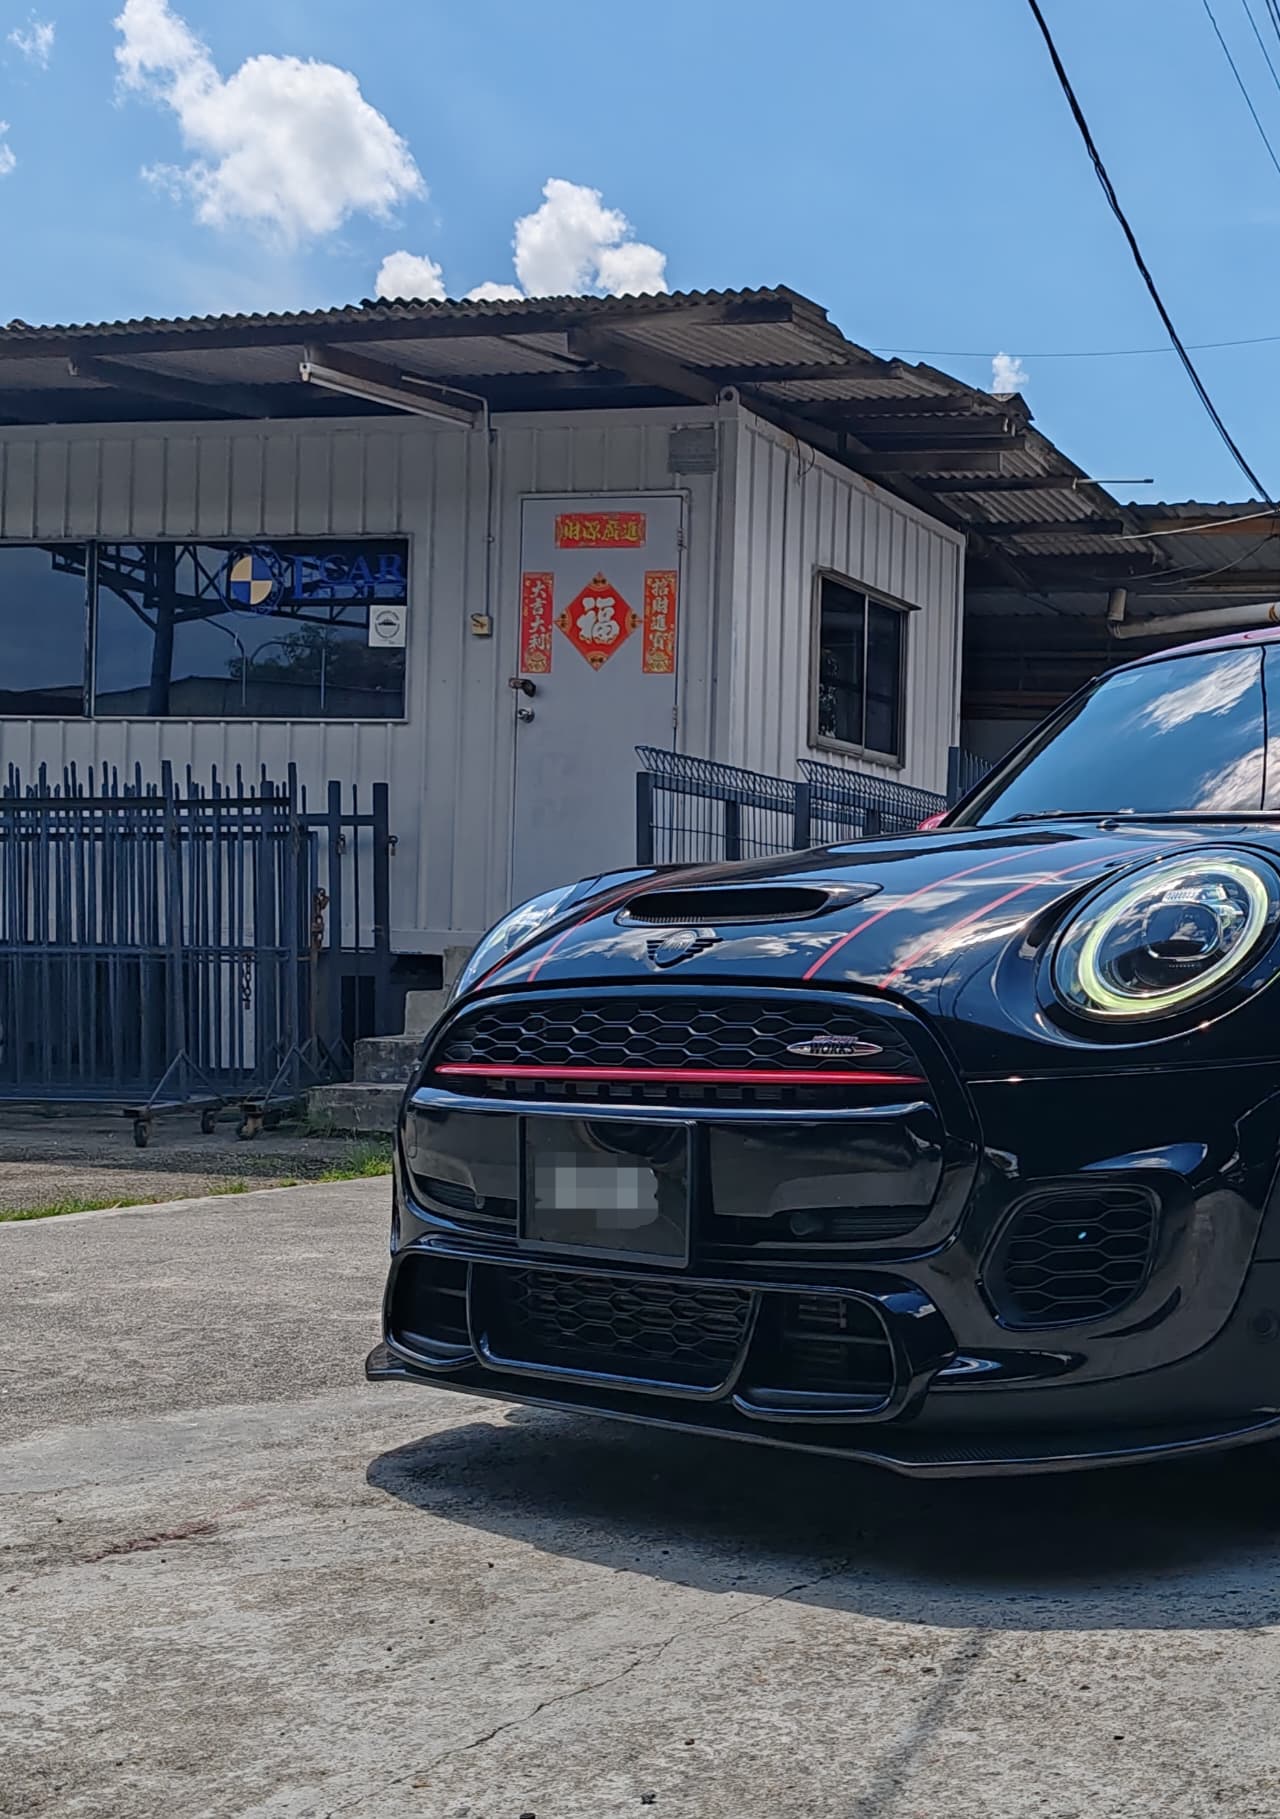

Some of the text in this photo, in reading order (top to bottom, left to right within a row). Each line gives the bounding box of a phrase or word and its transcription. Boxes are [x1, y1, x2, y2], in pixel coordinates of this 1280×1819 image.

[529, 580, 547, 650] 大吉大利
[577, 597, 620, 645] 福
